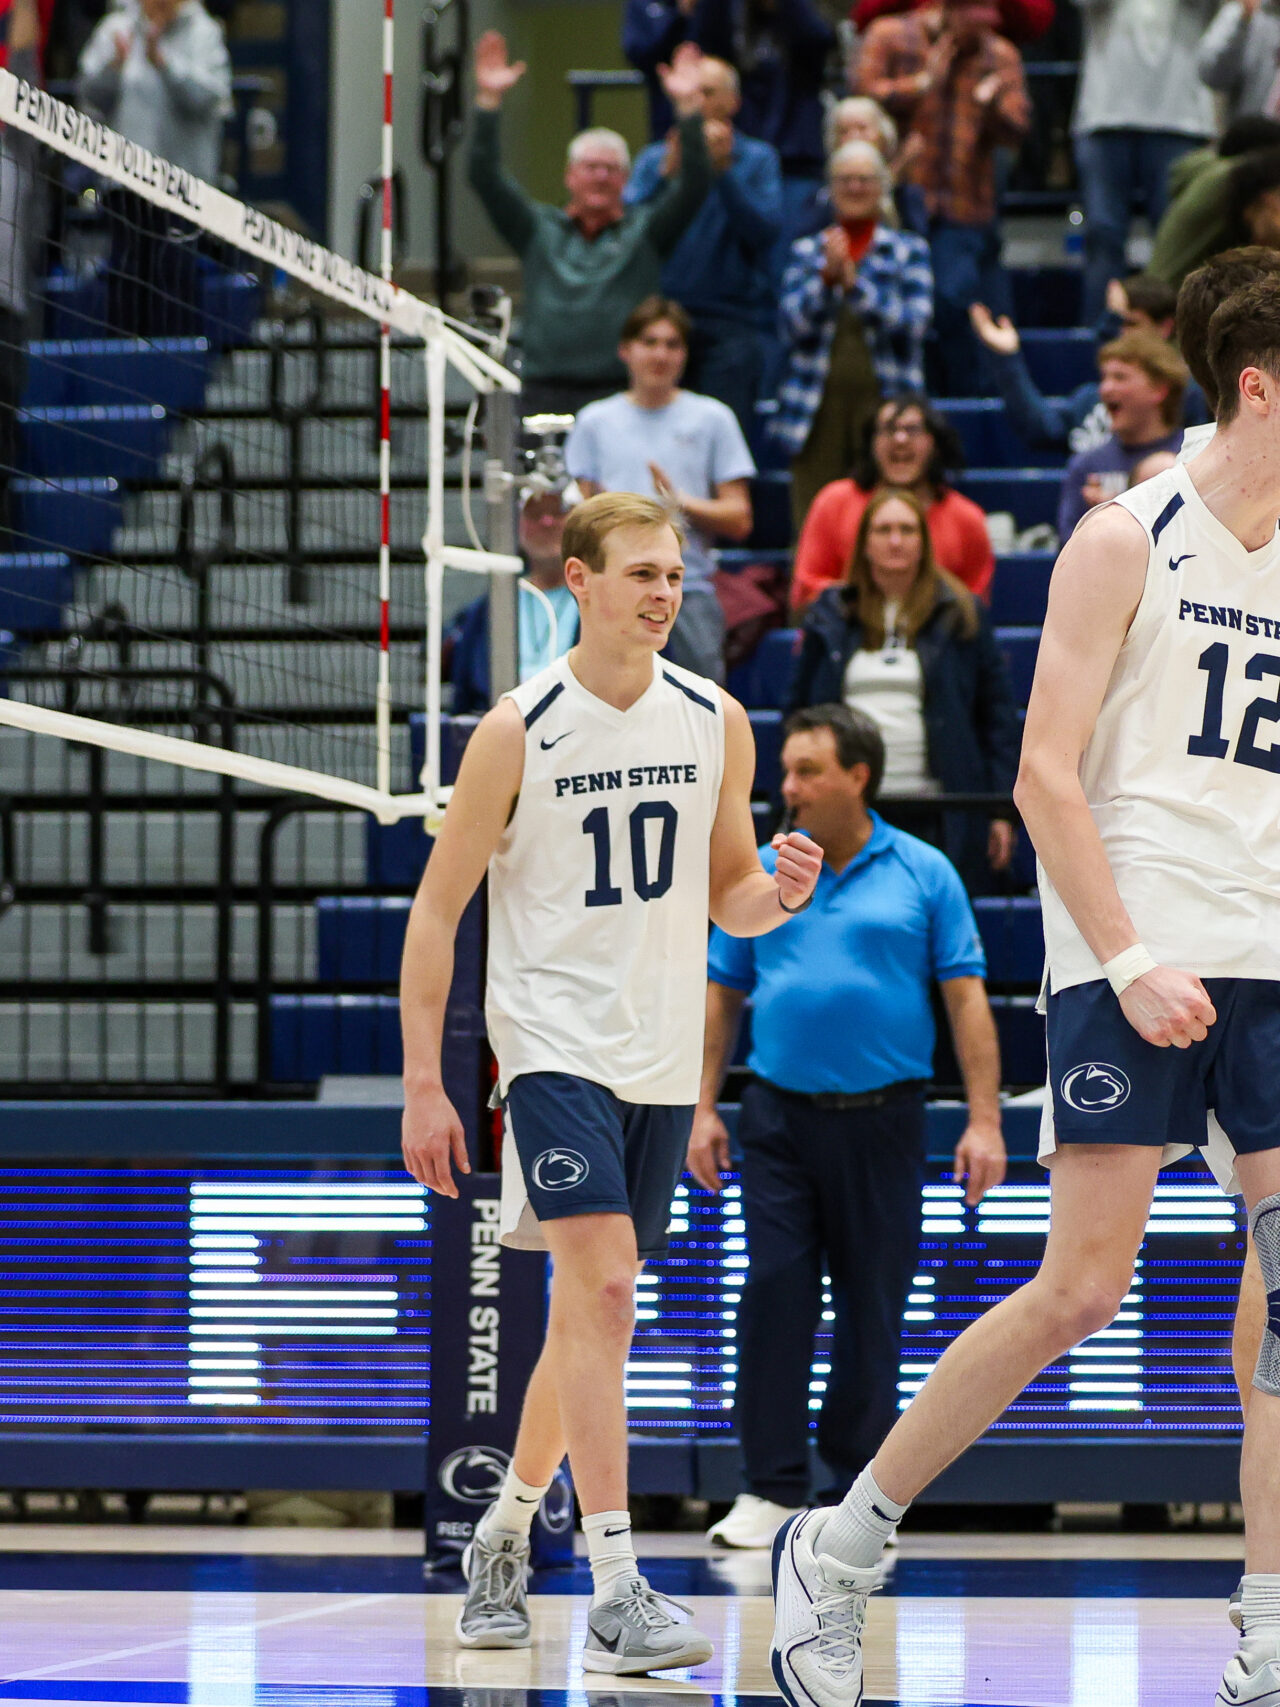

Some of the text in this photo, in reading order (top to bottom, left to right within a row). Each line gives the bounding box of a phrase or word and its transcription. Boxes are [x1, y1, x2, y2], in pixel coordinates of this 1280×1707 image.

[15, 79, 201, 211] PENN STATE VOLLEYBALL
[1178, 598, 1243, 631] PENN
[555, 764, 697, 797] PENN STATE
[582, 800, 678, 907] 10
[467, 1198, 501, 1414] PENN STATE
[436, 1521, 473, 1537] REC
